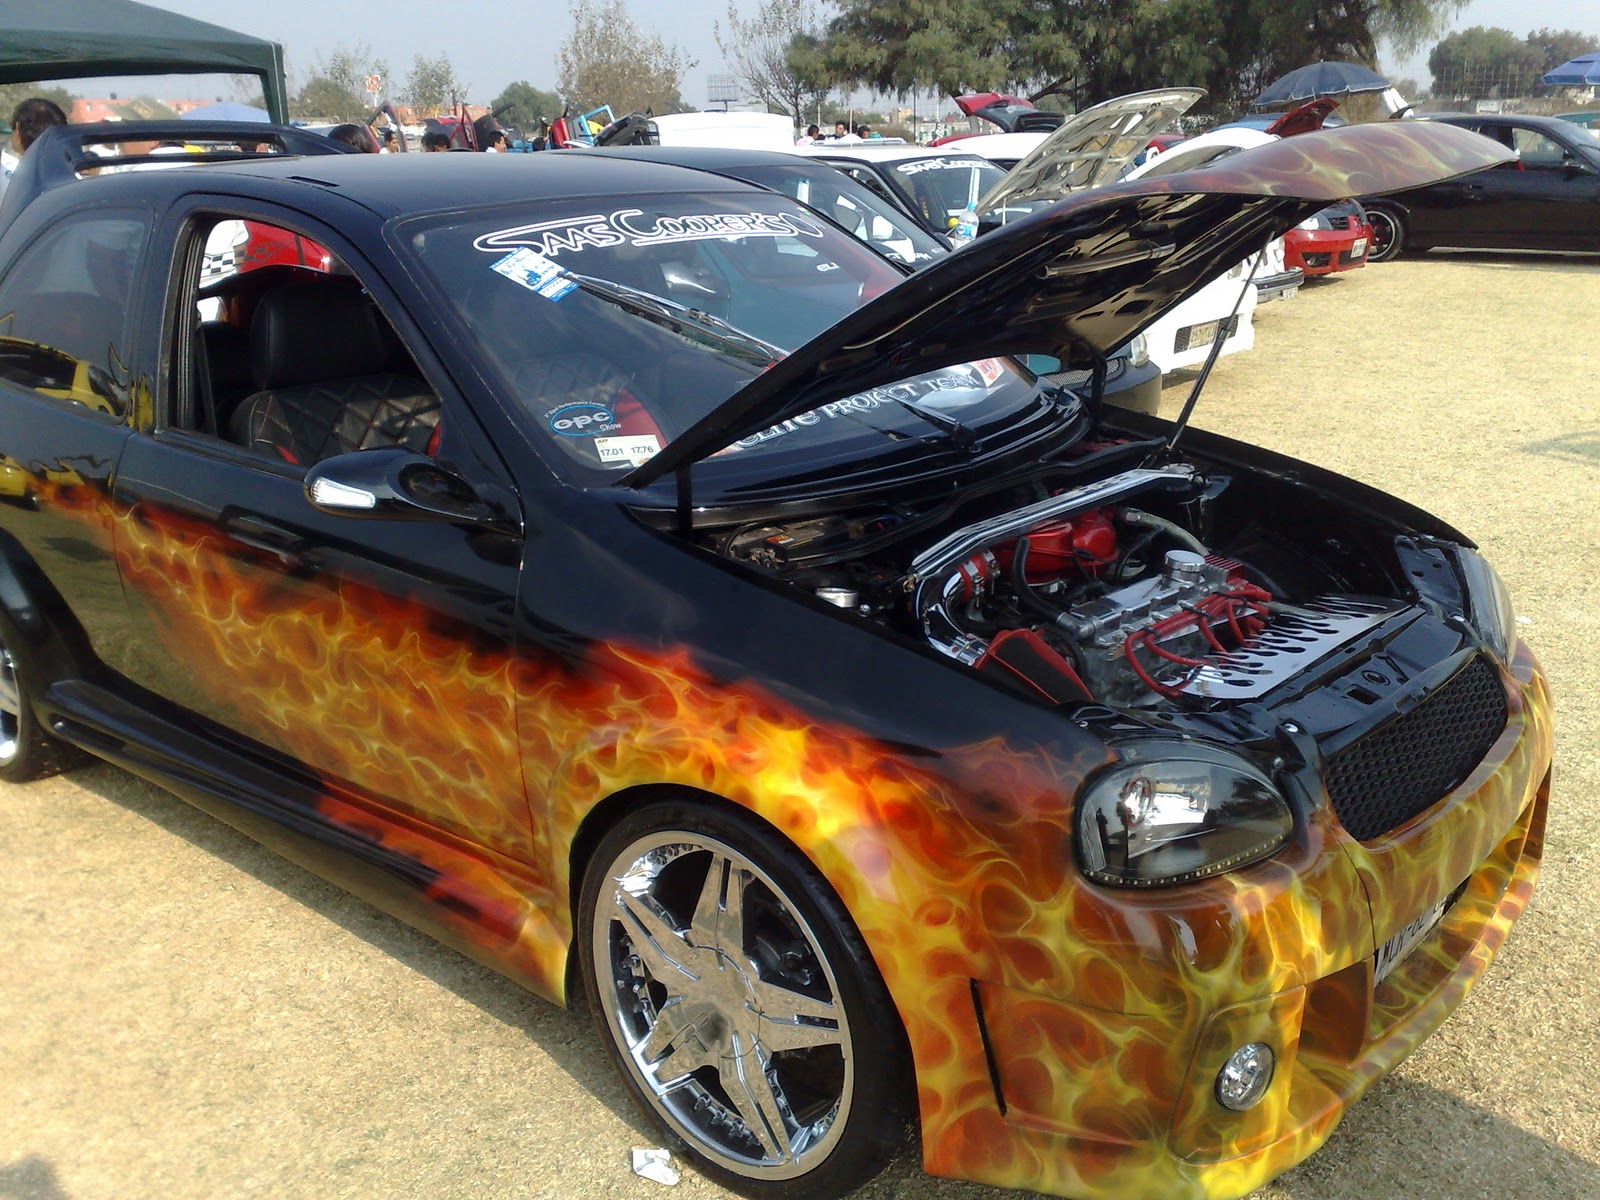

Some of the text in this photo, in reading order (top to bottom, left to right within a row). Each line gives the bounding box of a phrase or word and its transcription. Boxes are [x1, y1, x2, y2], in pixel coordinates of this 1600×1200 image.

[599, 422, 622, 432] Show
[600, 445, 654, 457] 17.01 17.76
